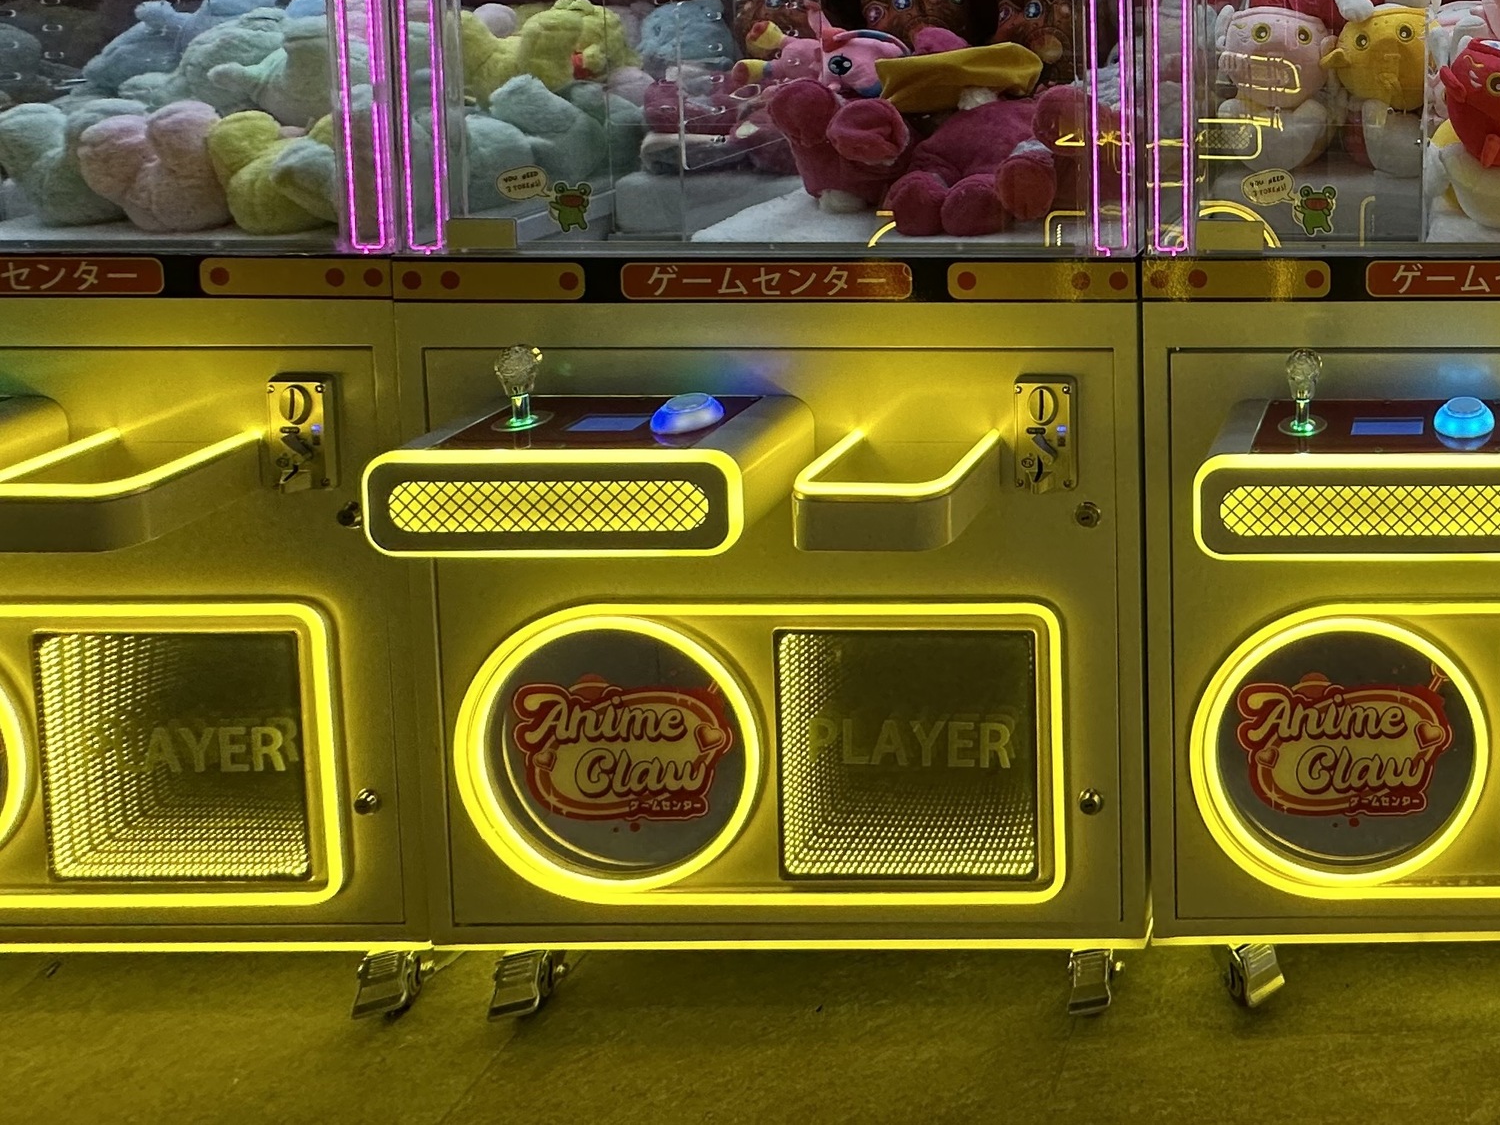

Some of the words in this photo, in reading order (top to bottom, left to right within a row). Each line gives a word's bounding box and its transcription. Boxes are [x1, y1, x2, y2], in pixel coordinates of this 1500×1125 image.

[645, 264, 888, 297] ゲームセンター
[523, 693, 688, 743] Anime
[1247, 692, 1407, 741] Anime
[808, 716, 1011, 769] PLAYER
[575, 747, 708, 798] Claw
[1296, 745, 1426, 794] Claw
